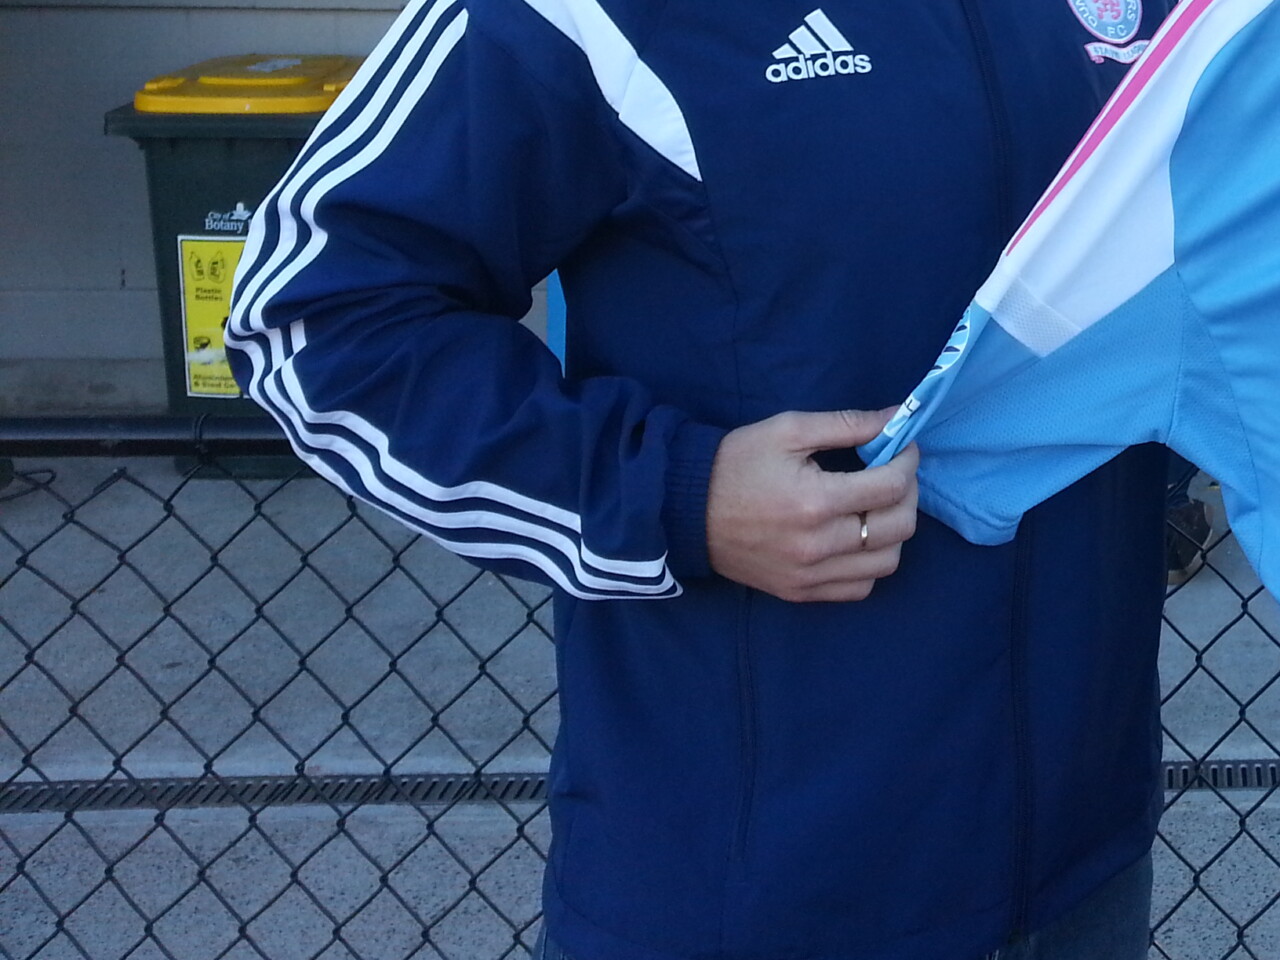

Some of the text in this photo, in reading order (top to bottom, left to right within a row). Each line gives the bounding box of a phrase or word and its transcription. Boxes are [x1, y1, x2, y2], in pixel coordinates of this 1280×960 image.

[1107, 24, 1127, 37] FC
[765, 50, 873, 83] adidas
[204, 218, 244, 234] Botany
